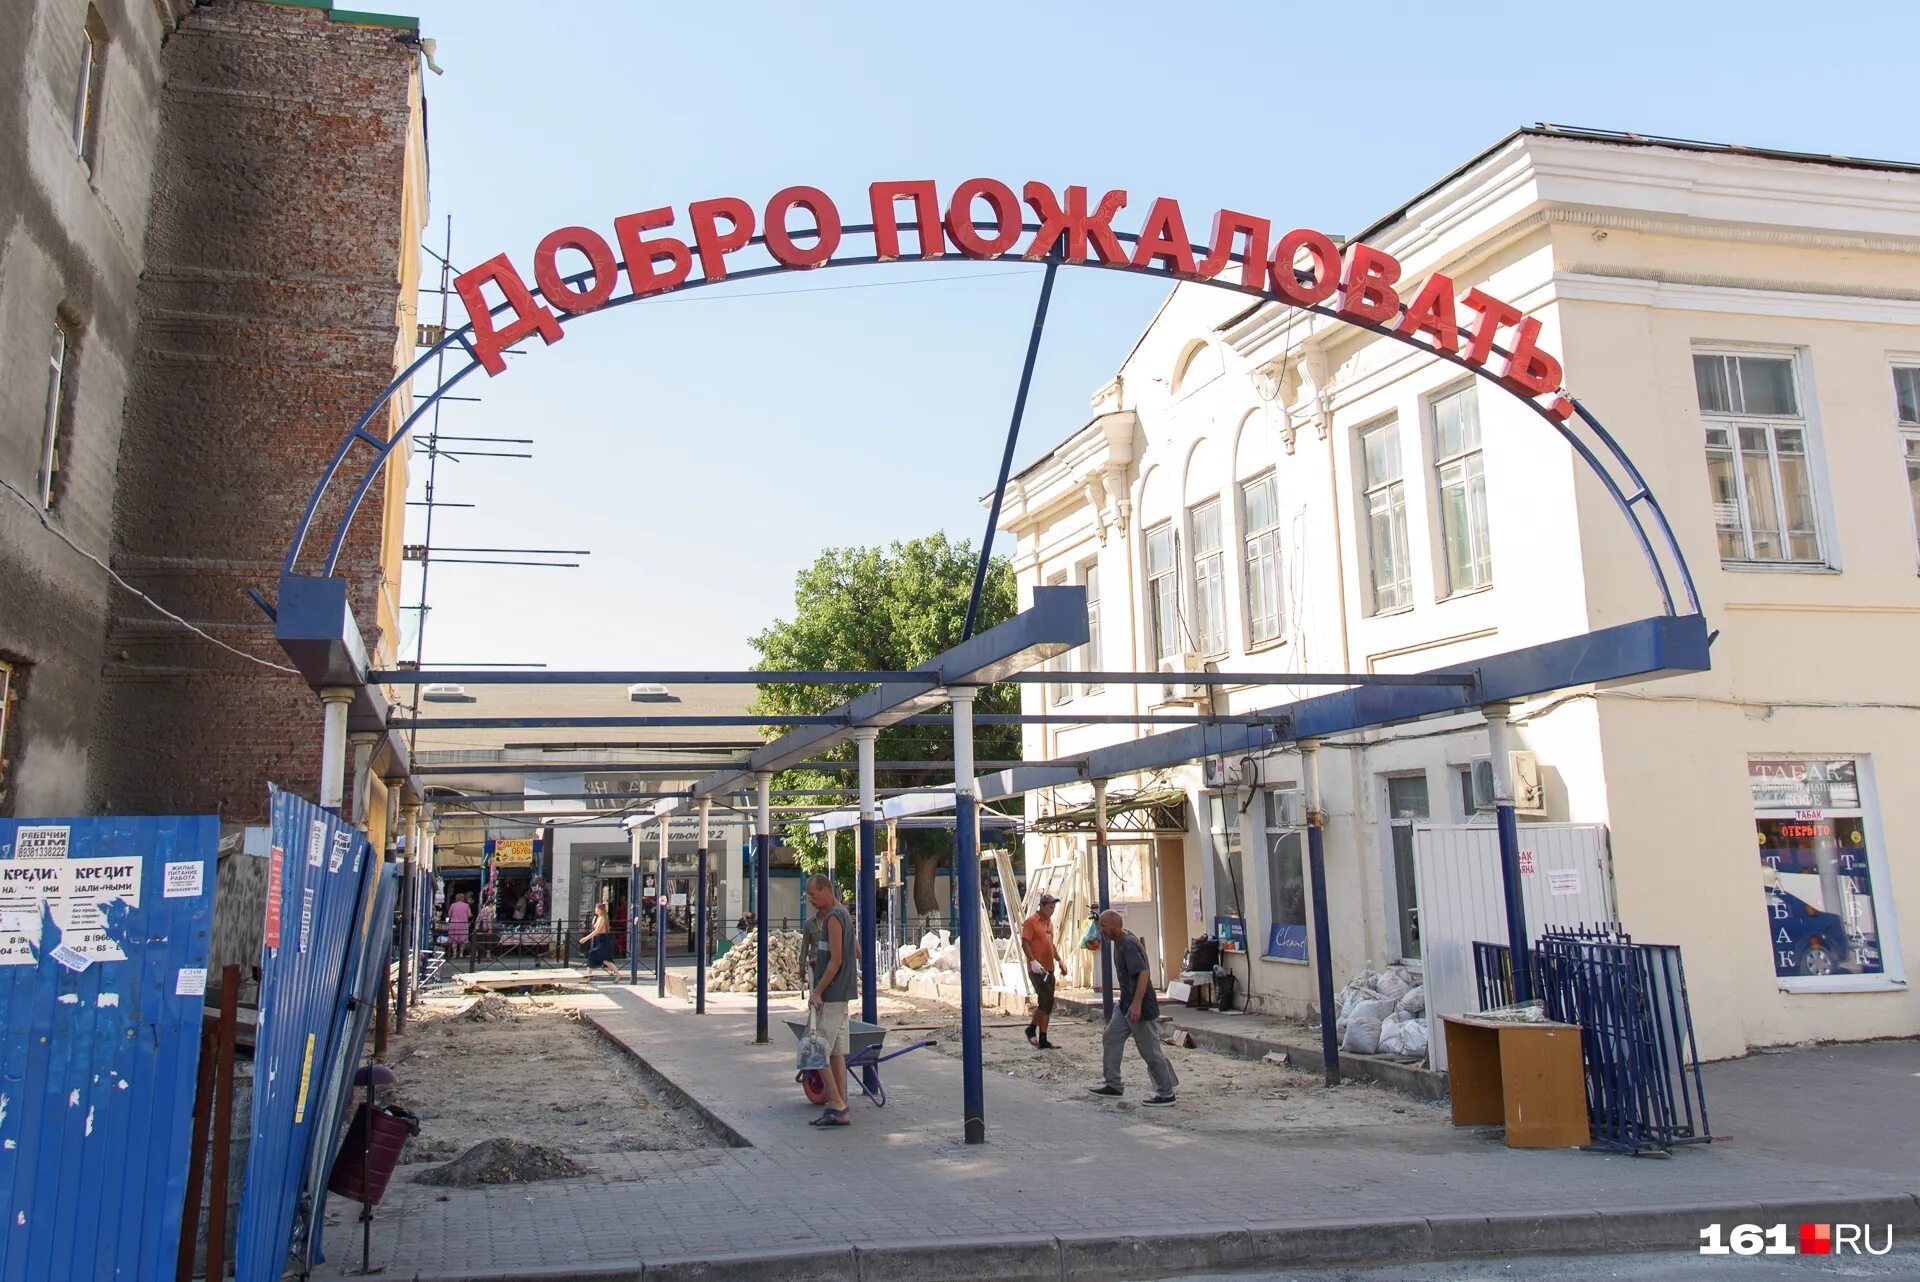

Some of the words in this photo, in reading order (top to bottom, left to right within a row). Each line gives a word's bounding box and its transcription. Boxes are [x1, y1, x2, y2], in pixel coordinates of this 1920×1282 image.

[453, 185, 842, 377] ДОБРО
[1756, 765, 1842, 781] ТАБАК
[1796, 810, 1821, 819] ТАБАК
[715, 830, 724, 839] 2
[1782, 826, 1830, 837] ОТКРЫТО
[20, 839, 66, 847] ДОМ
[1767, 856, 1796, 967] ТАБАК
[1841, 854, 1870, 965] ТАБАК
